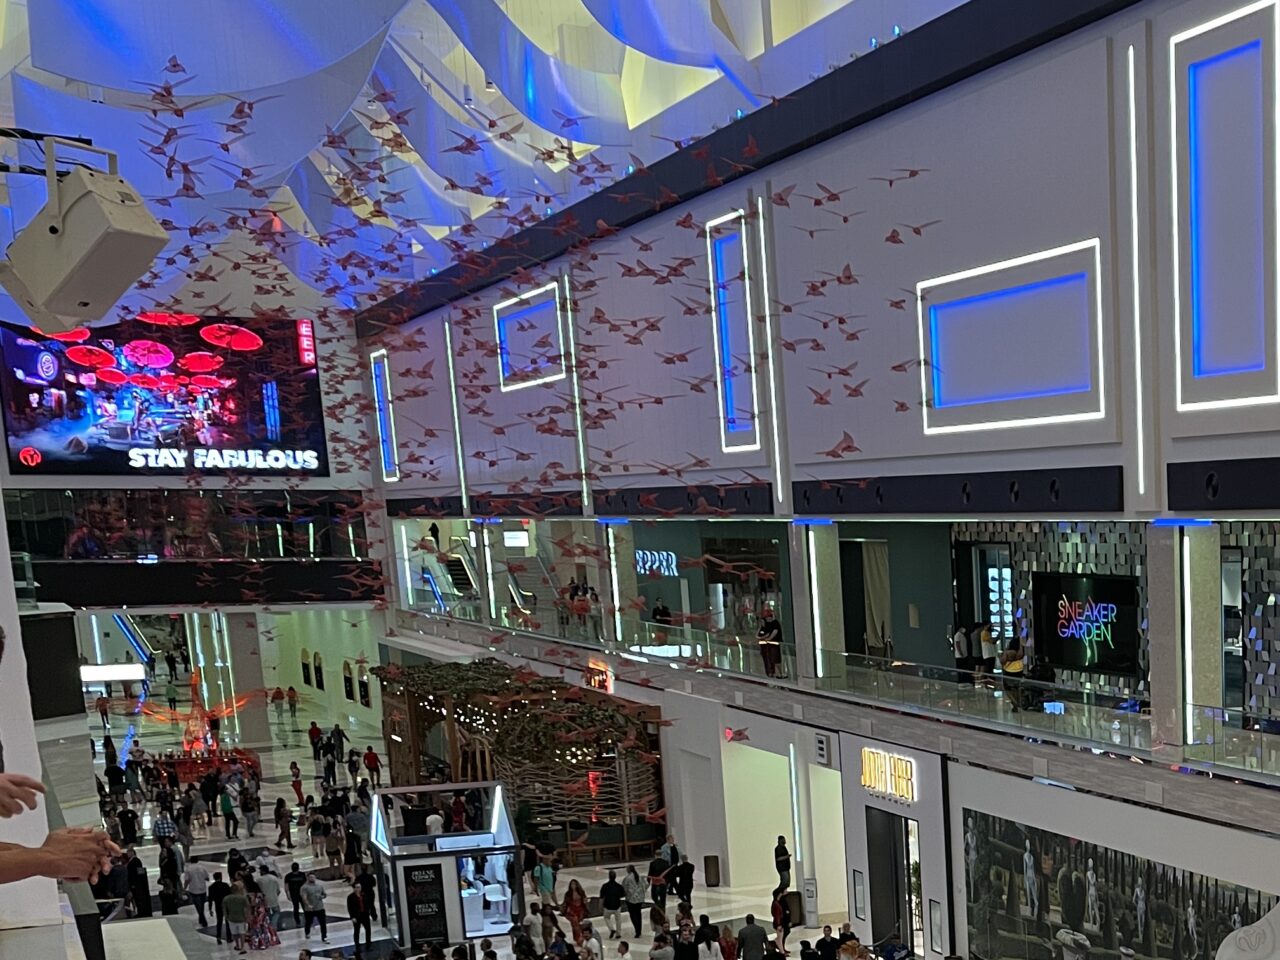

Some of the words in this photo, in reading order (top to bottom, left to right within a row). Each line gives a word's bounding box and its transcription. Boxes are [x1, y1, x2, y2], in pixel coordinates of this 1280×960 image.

[302, 319, 316, 364] EER
[128, 448, 187, 468] STAY
[194, 449, 319, 469] FABULOUS
[635, 549, 679, 577] EPPER
[1057, 595, 1117, 624] SNEAKER
[1057, 619, 1114, 649] GARDEN
